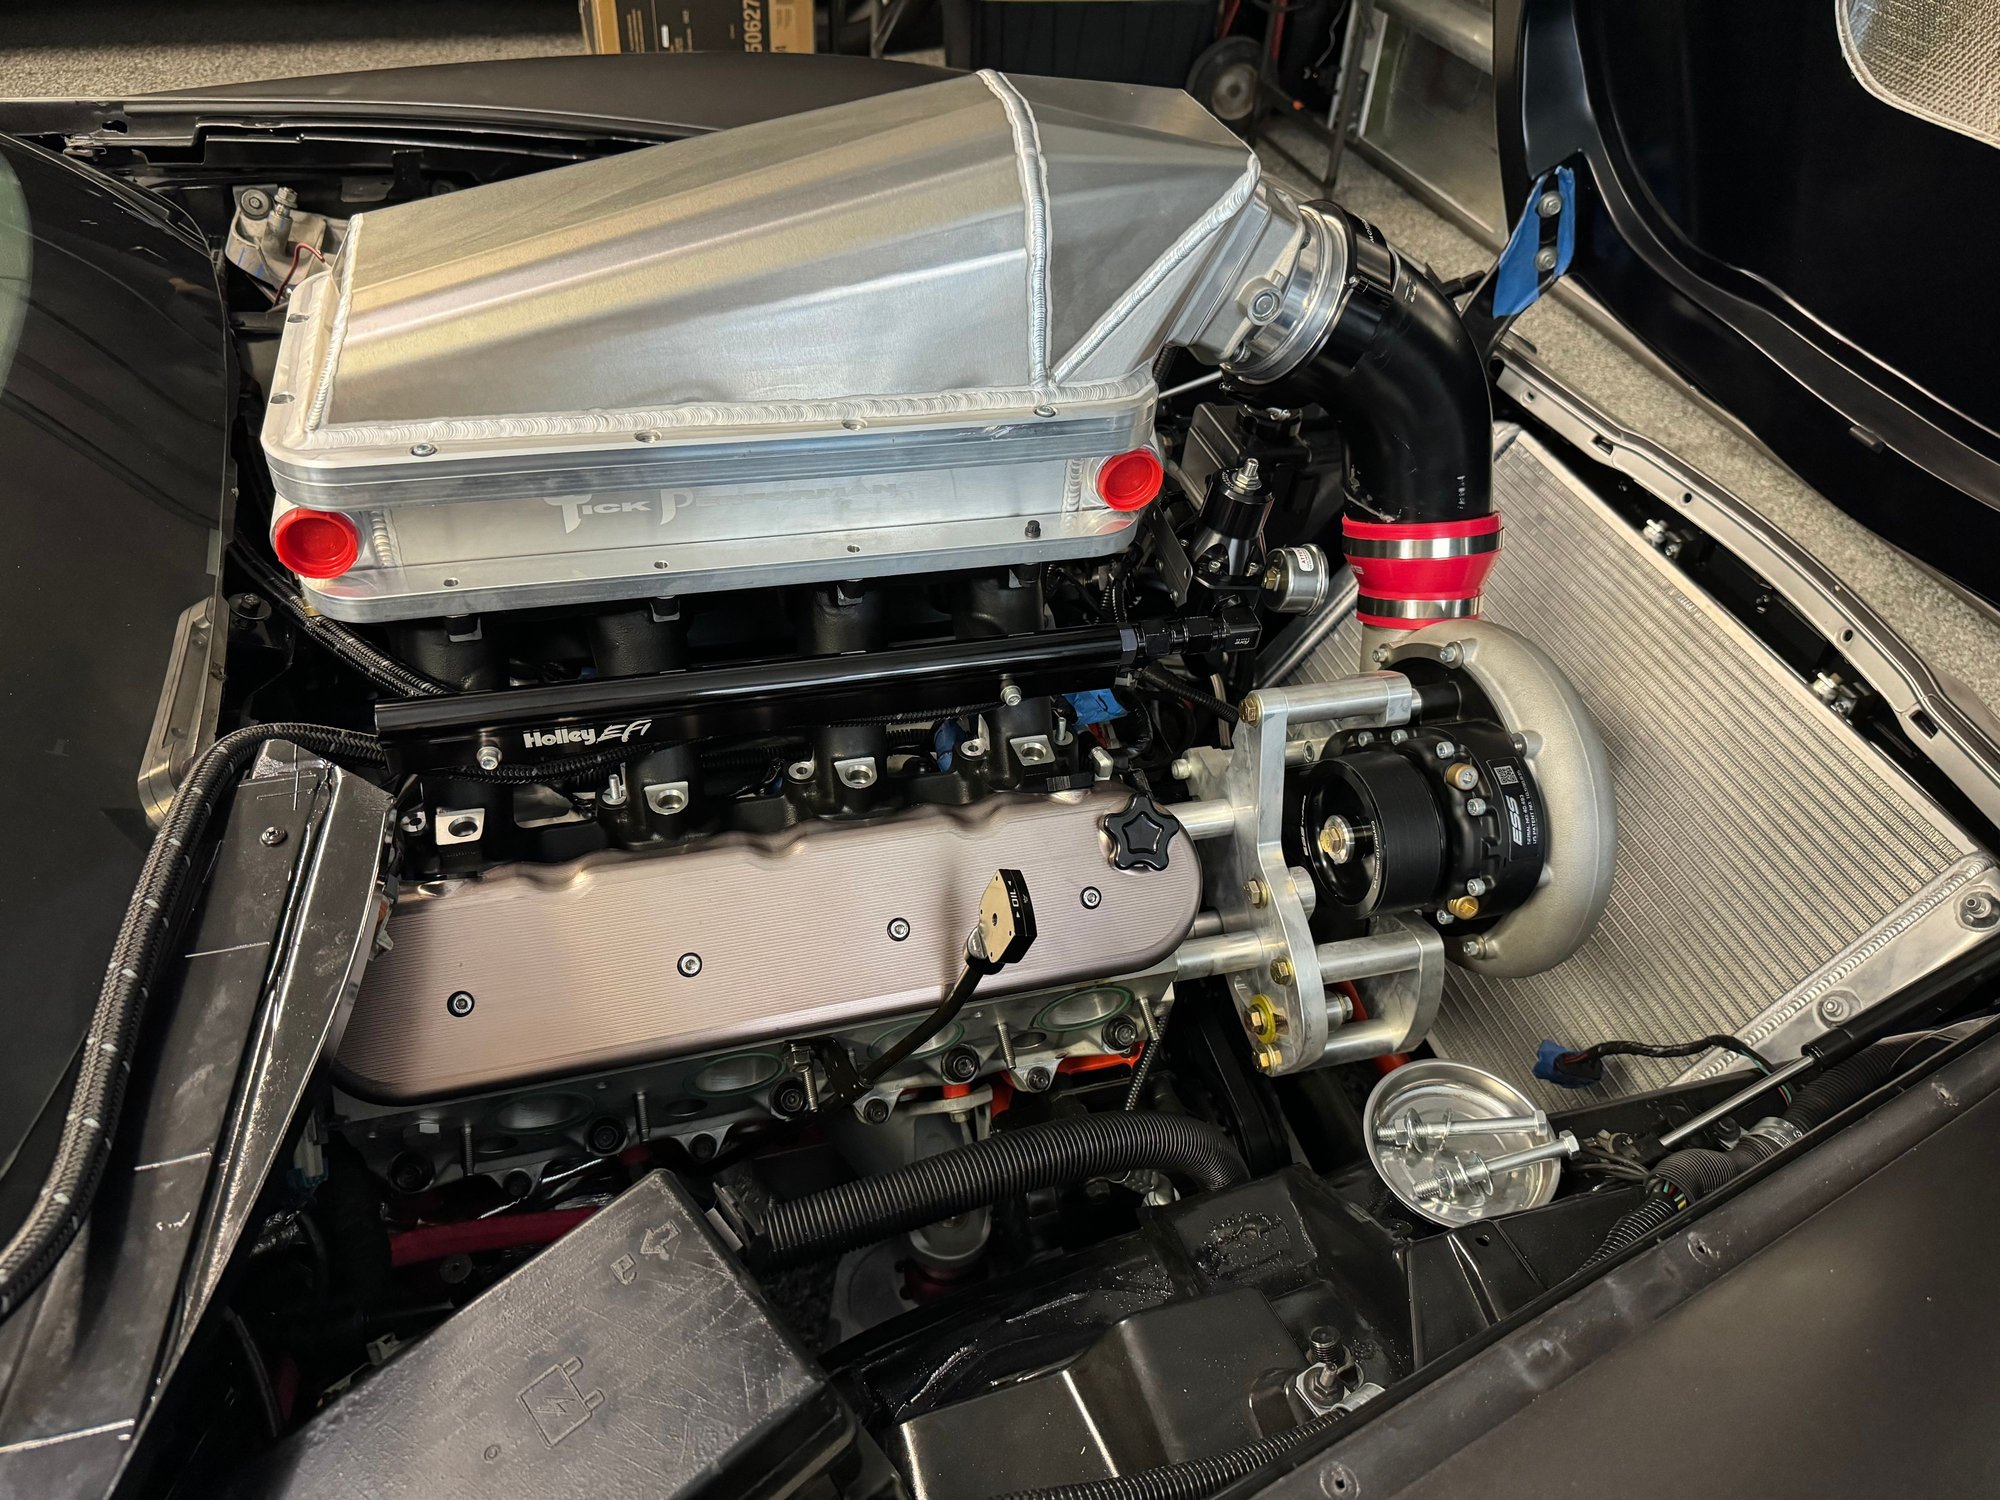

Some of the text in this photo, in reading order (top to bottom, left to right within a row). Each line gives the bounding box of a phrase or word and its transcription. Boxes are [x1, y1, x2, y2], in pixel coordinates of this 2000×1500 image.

[523, 719, 653, 749] Holley EFI
[1505, 794, 1523, 846] ESS
[1532, 835, 1537, 844] US
[1010, 889, 1019, 907] OIL
